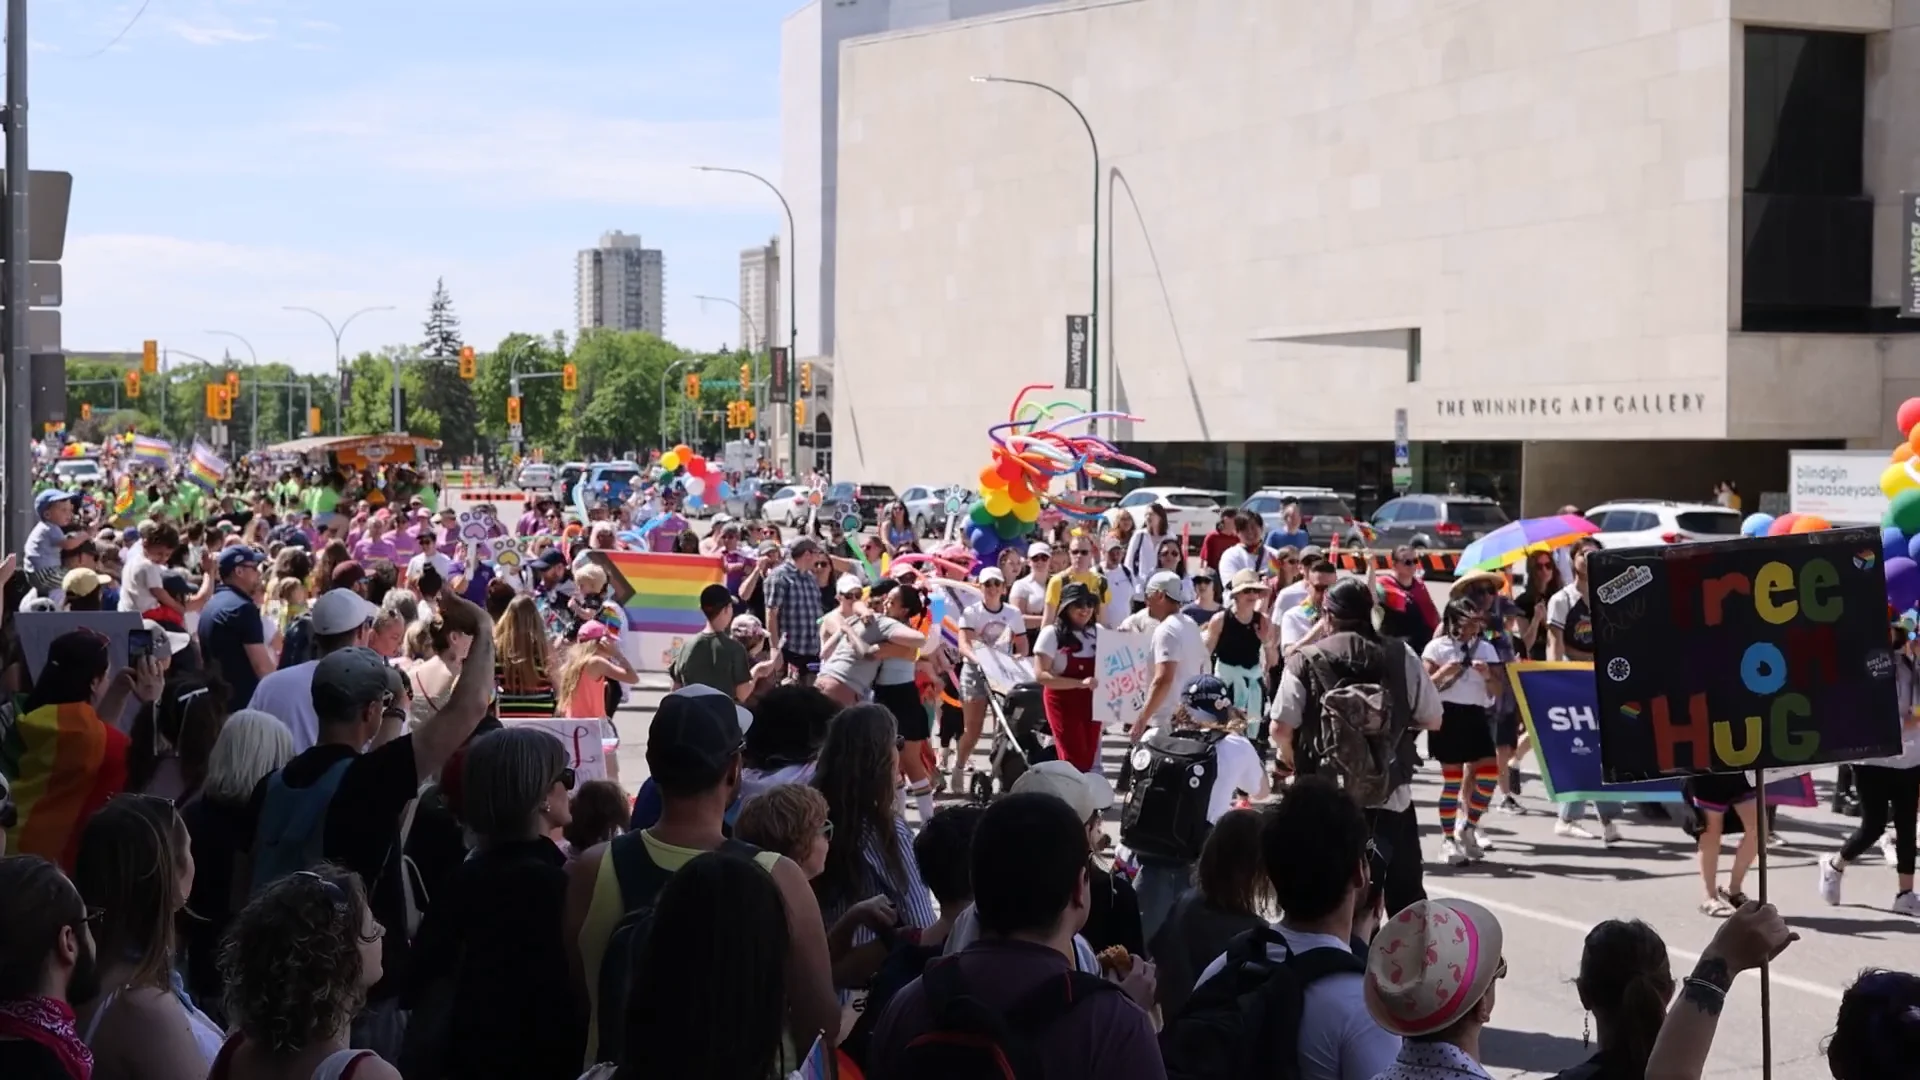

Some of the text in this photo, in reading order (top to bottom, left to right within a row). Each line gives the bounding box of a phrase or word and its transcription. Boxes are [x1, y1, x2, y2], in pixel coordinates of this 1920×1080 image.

[1437, 393, 1705, 416] THE WINNIPEG ART GALLERY
[1547, 705, 1600, 731] SH
